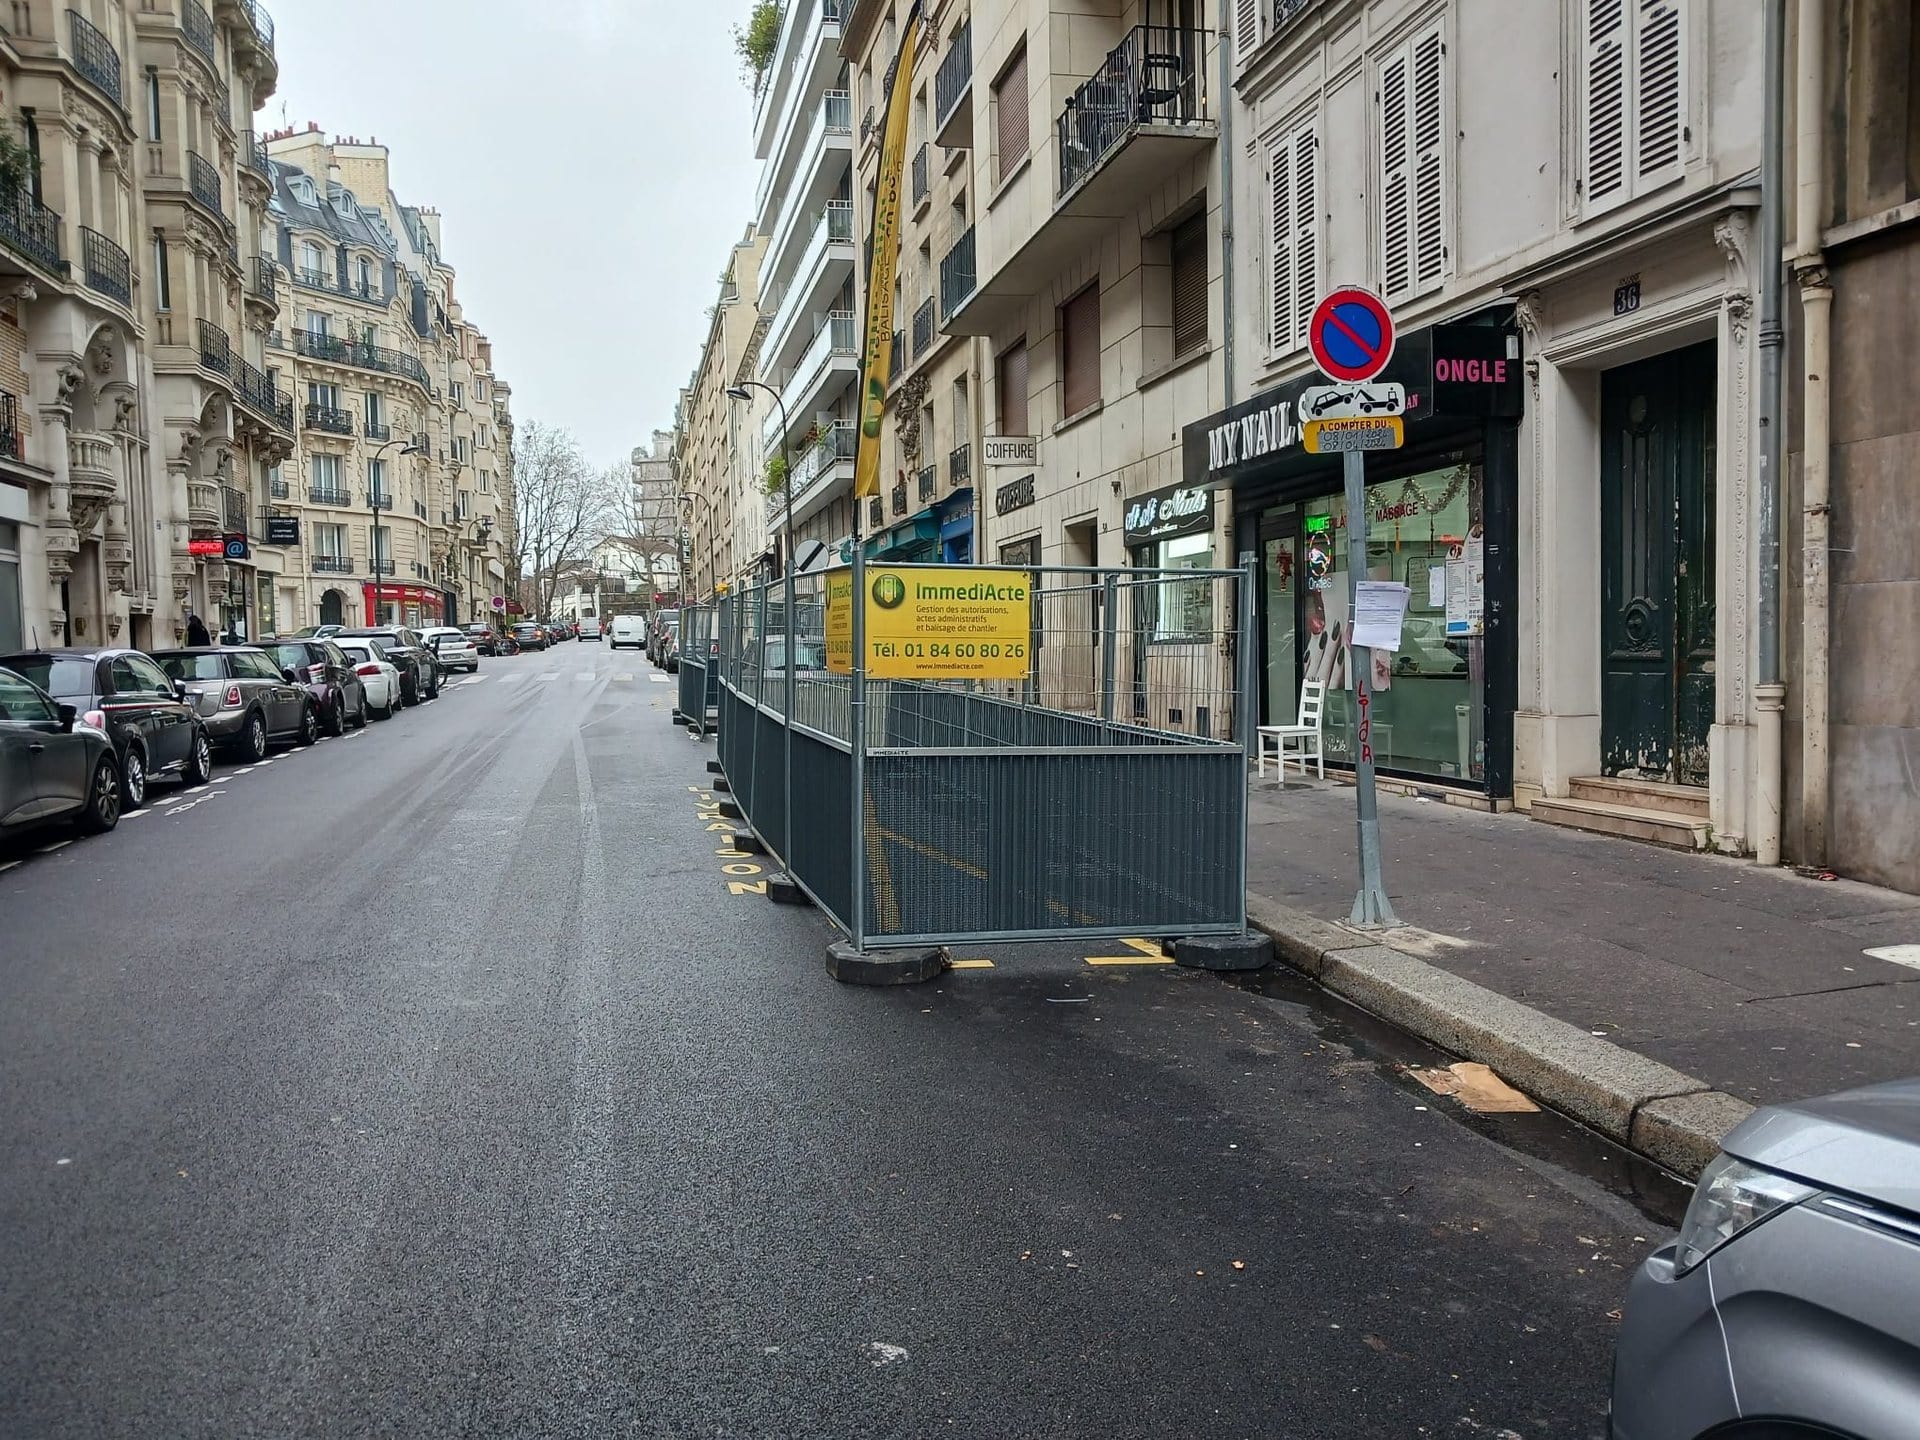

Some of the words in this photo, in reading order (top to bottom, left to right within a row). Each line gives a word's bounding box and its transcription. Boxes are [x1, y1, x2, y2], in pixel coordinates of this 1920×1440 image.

[1617, 286, 1637, 313] 36
[1436, 358, 1506, 383] ONGLE
[1319, 423, 1326, 432] A
[1327, 420, 1371, 431] COMPTER
[1375, 420, 1387, 429] DU
[985, 443, 1034, 459] COIFFURE
[1208, 423, 1238, 471] MY
[996, 474, 1035, 516] COIFFURE
[1375, 501, 1419, 523] MASSAGE
[916, 582, 1025, 601] ImmediActe
[916, 604, 944, 614] Gestion
[945, 605, 959, 614] des
[960, 605, 1009, 615] autorisations,
[916, 614, 936, 623] actes
[937, 614, 987, 623] administratifs
[916, 624, 924, 632] et
[925, 623, 957, 633] balisage
[957, 624, 968, 632] de
[969, 624, 998, 632] chantier
[873, 642, 899, 657] Tél.
[904, 643, 924, 657] 01
[930, 643, 950, 657] 84
[955, 643, 975, 657] 60
[980, 643, 1000, 658] 80
[1004, 643, 1024, 658] 26
[916, 662, 984, 671] www.immediacte.com
